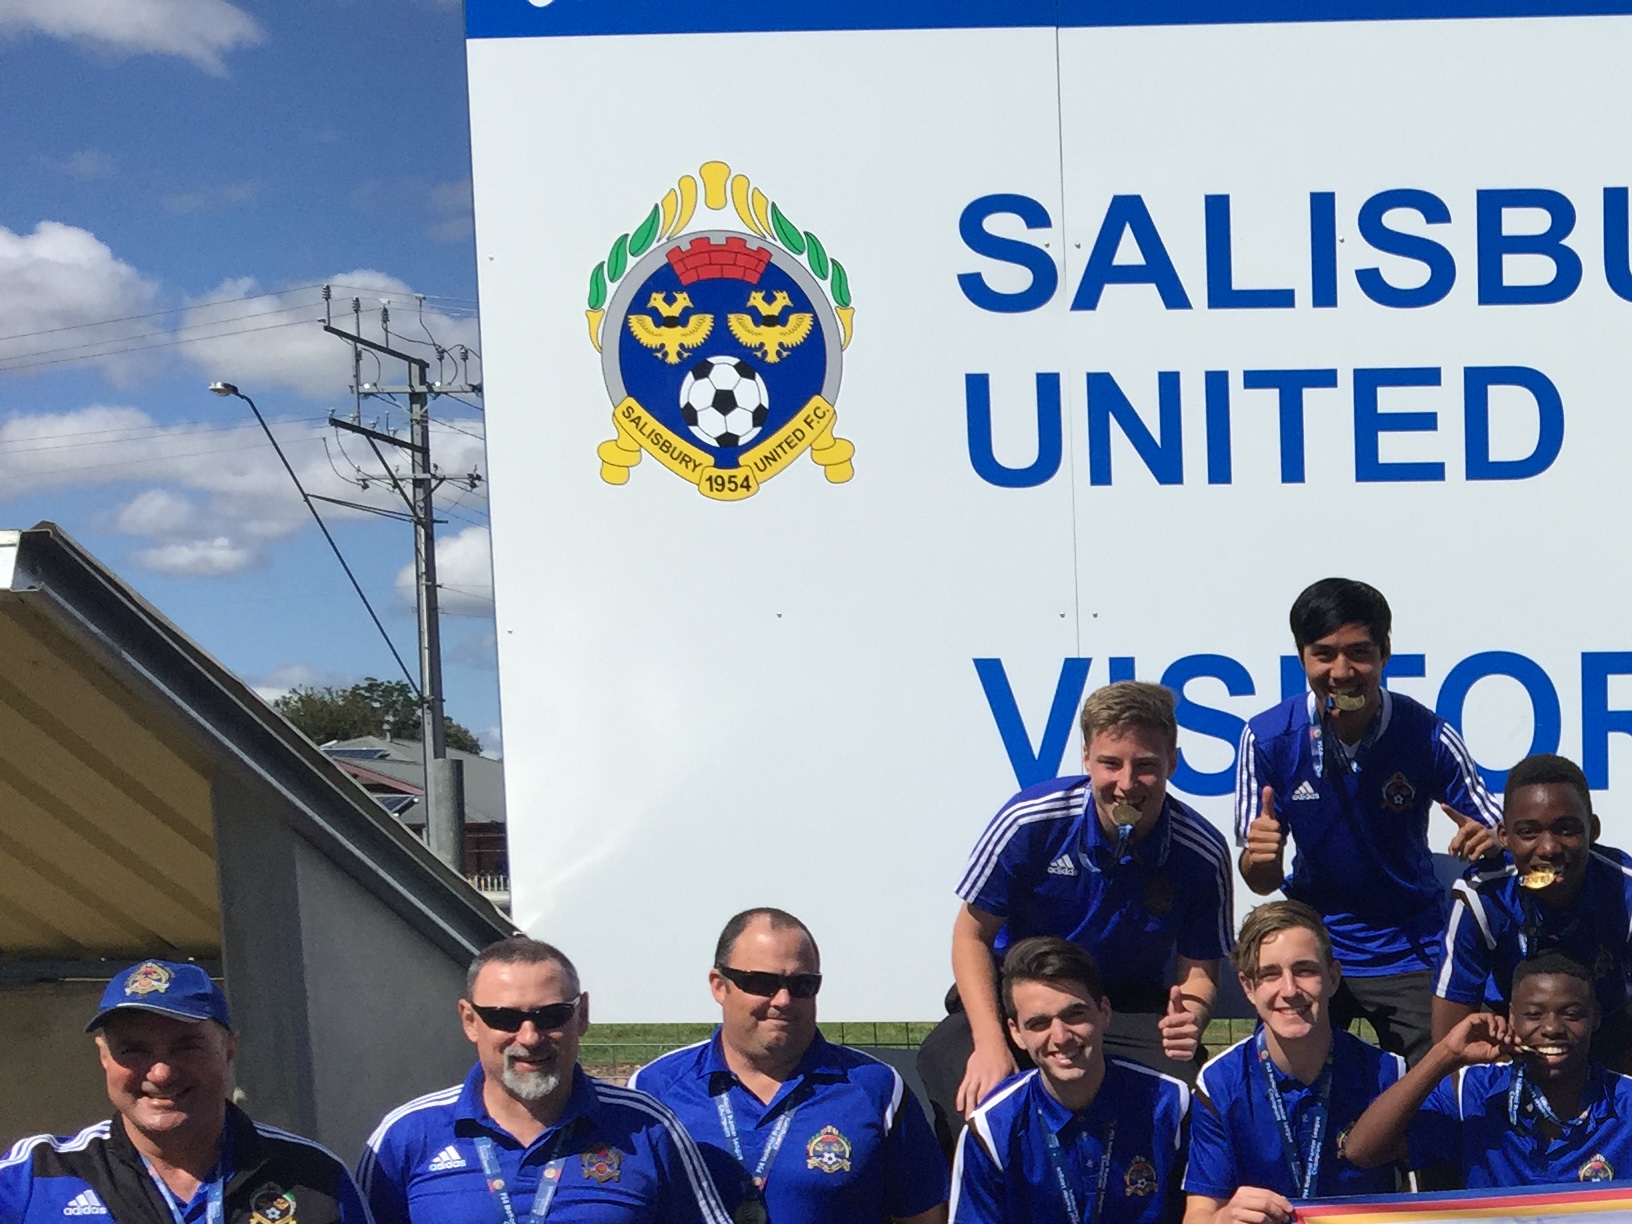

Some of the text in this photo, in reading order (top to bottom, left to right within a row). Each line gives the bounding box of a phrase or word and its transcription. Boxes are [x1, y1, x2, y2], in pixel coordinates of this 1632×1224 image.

[621, 405, 702, 473] SALISBURY
[754, 405, 830, 473] UNITED F.C.
[965, 363, 1564, 487] UNITED
[705, 474, 752, 493] 1954
[428, 1159, 467, 1171] adidas
[63, 1204, 107, 1216] adidas
